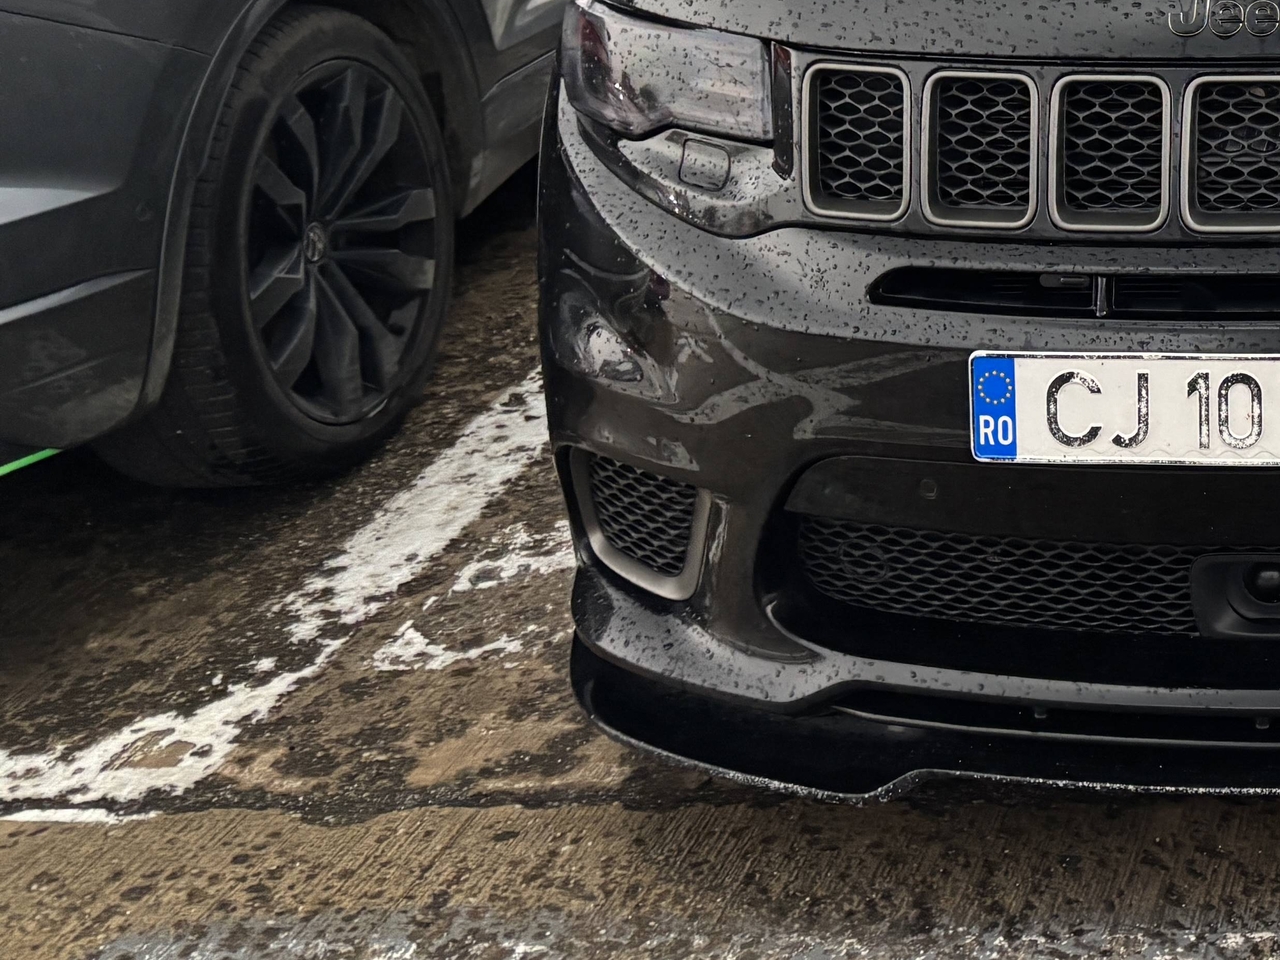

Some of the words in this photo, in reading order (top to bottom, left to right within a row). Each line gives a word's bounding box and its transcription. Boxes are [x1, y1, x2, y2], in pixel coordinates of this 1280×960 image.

[979, 415, 1014, 446] RO
[1045, 370, 1151, 449] CJ
[1186, 371, 1264, 450] 10
